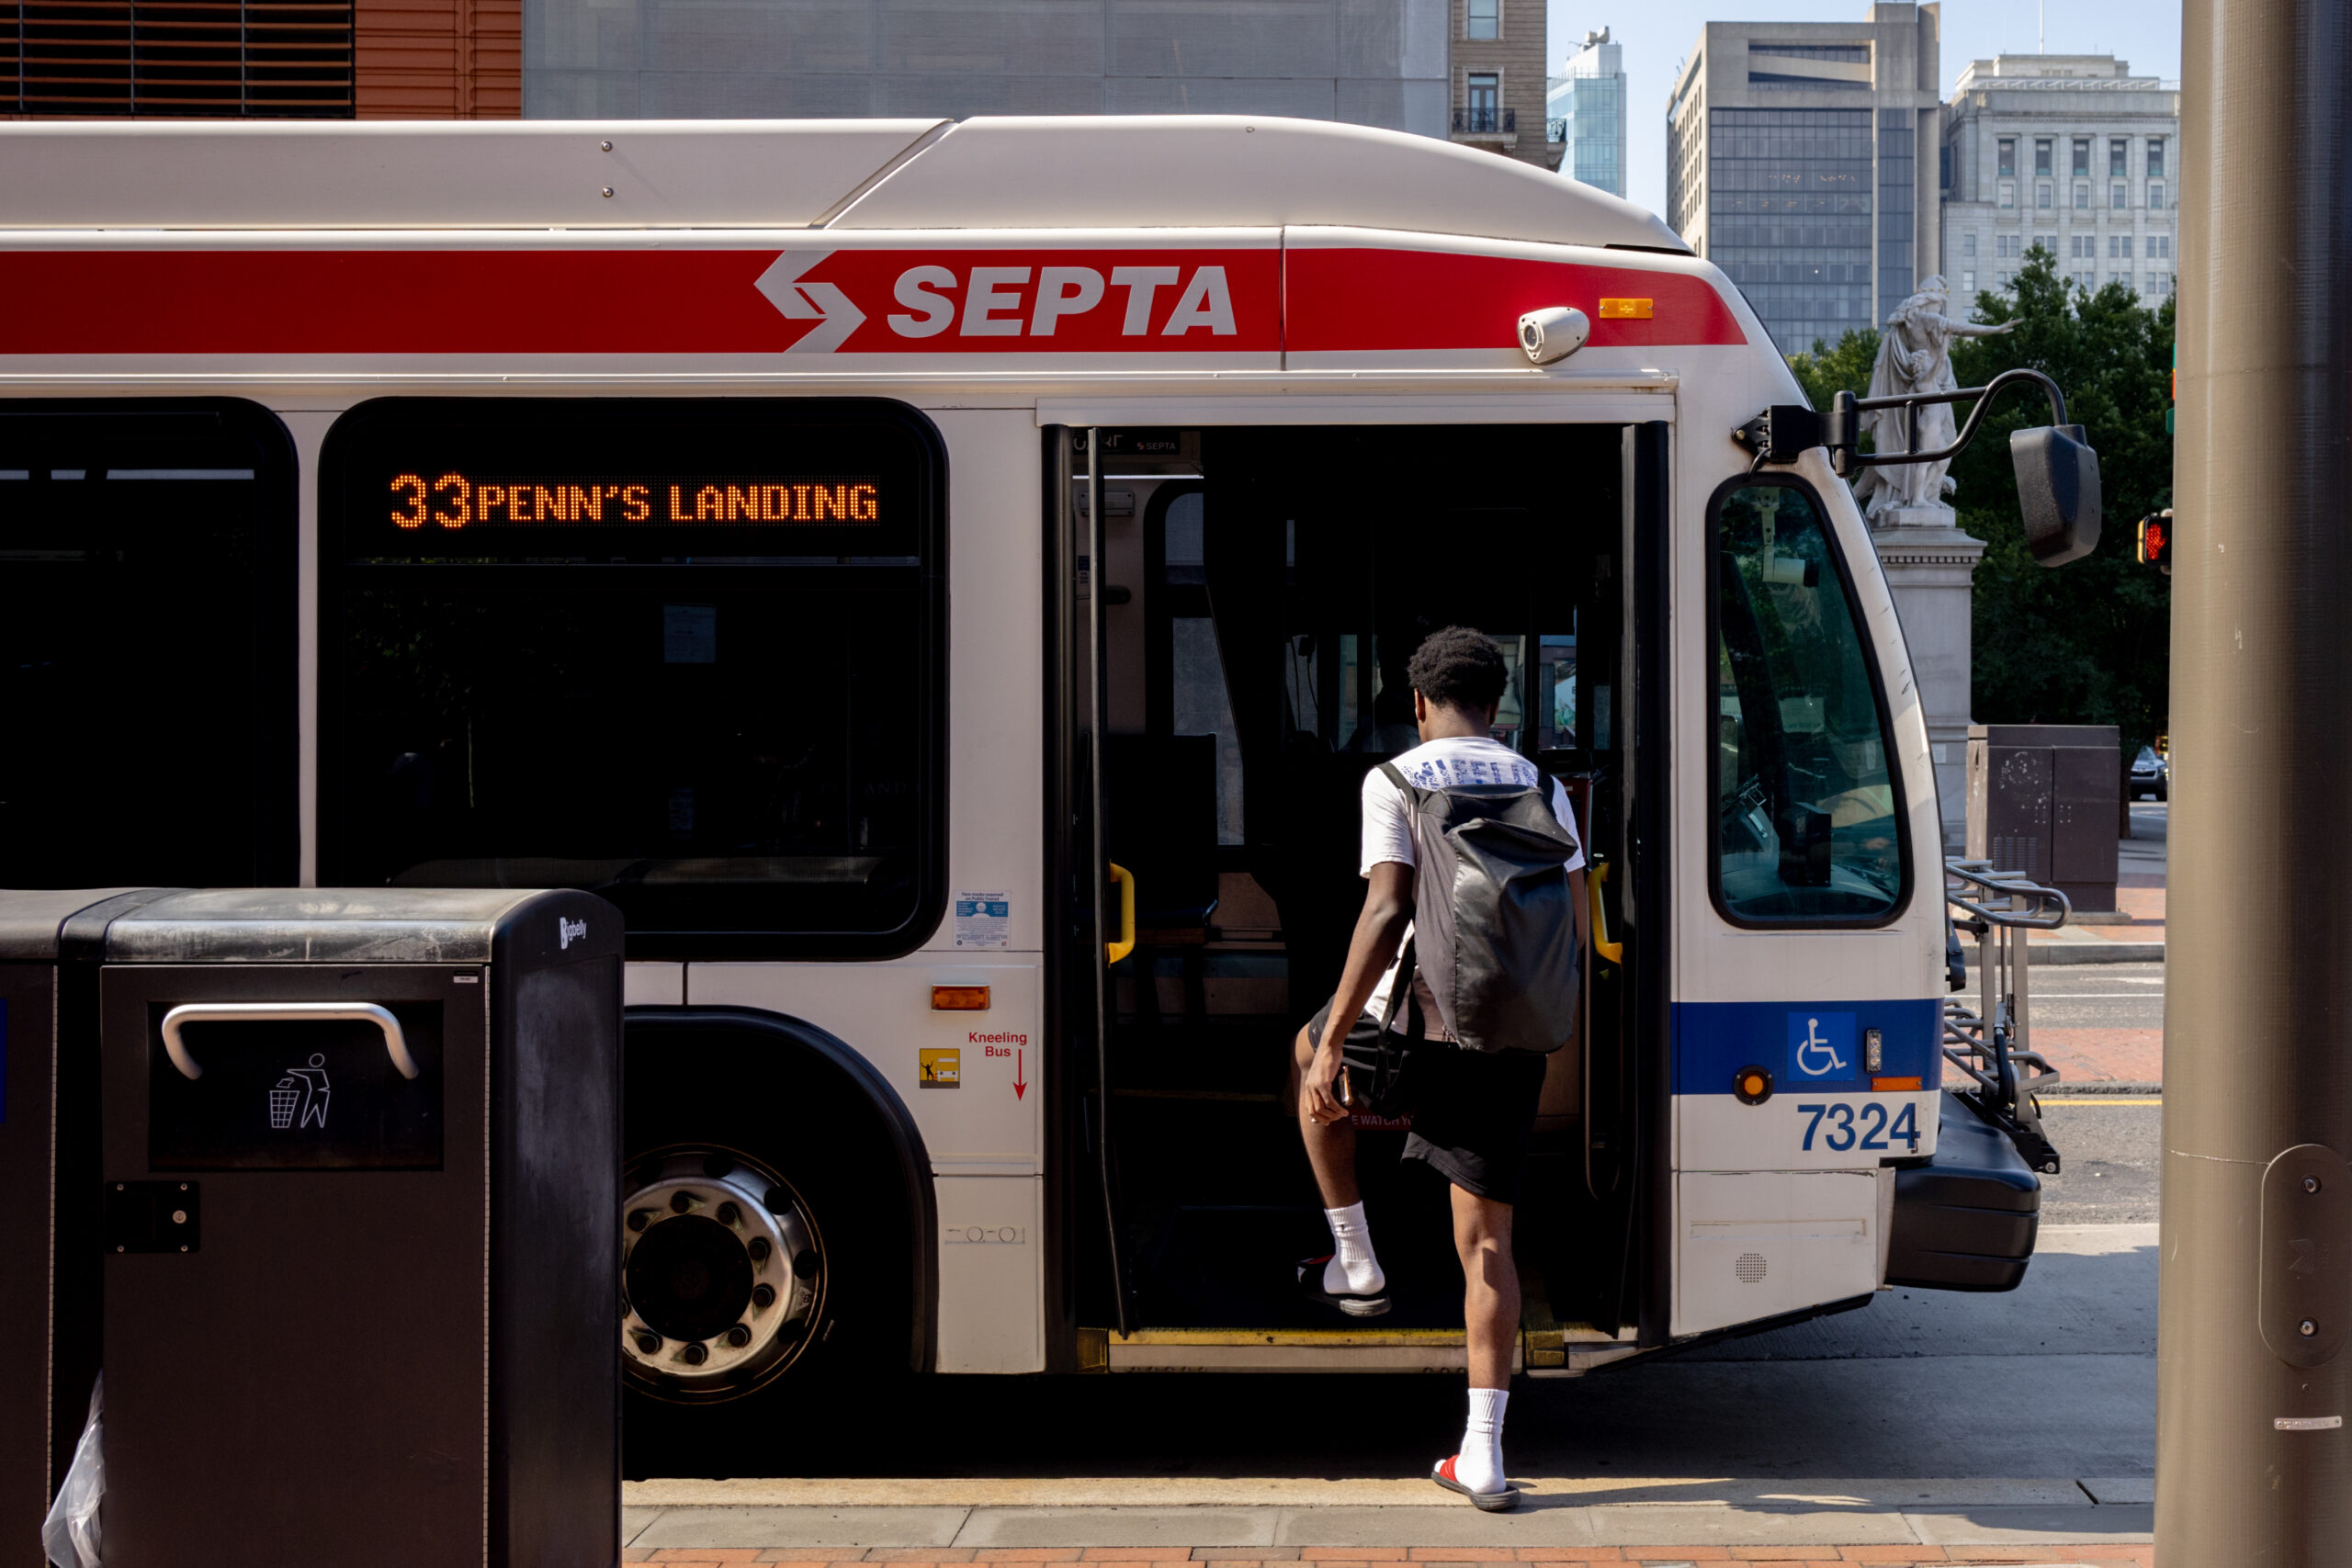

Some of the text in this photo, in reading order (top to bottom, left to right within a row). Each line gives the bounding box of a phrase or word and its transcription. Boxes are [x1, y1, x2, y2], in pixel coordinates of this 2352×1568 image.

[887, 265, 1238, 338] SEPTA
[1146, 442, 1176, 451] SEPTA
[390, 474, 877, 529] 33 PENN'S LANDING
[560, 917, 587, 950] Bigbelly
[968, 1032, 1027, 1045] Kneeling
[985, 1046, 1011, 1057] Bus
[1798, 1103, 1920, 1152] 7324
